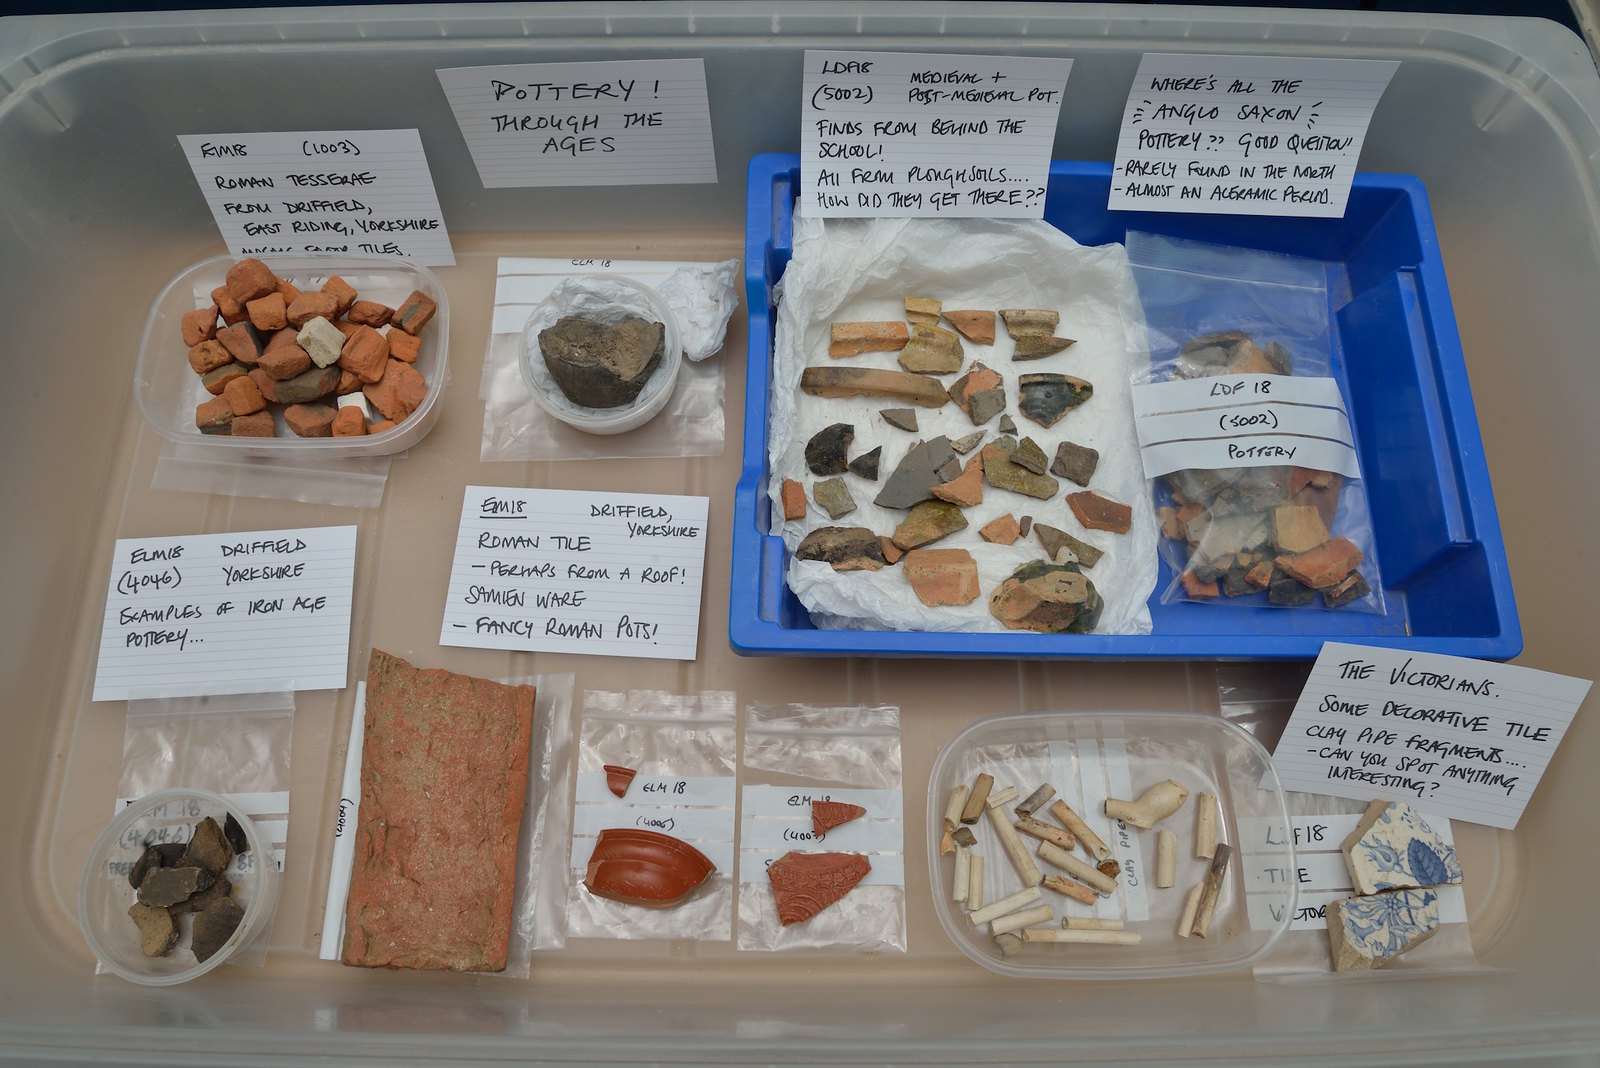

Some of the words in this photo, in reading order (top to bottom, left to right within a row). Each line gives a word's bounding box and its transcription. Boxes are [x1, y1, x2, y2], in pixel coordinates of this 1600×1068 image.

[910, 70, 983, 84] MEDIEVAL
[491, 80, 635, 102] POTTERY
[1227, 80, 1255, 93] ALL
[1272, 80, 1302, 94] THE
[812, 84, 873, 110] (5002)
[491, 115, 598, 134] THROUGH
[624, 112, 662, 128] THE
[1152, 104, 1218, 125] ANGLO
[1237, 105, 1301, 123] SAXON
[816, 120, 862, 137] FINDS
[874, 121, 916, 136] FROM
[931, 119, 988, 136] BEHIND
[997, 119, 1026, 134] THE
[303, 140, 360, 156] (1003)
[543, 136, 615, 156] AGES
[819, 142, 883, 161] SCHOOL!
[1238, 133, 1278, 157] GOOD
[1188, 161, 1230, 177] FOUND
[1240, 167, 1256, 178] IN
[1263, 164, 1288, 179] THE
[1293, 164, 1336, 179] NORTH
[215, 176, 274, 189] ROMAN
[286, 172, 376, 186] TESSERAE
[817, 192, 849, 209] HOW
[858, 193, 882, 208] DID
[887, 192, 922, 209] THEY
[930, 192, 961, 211] GET
[1181, 186, 1201, 199] AN
[224, 203, 272, 214] FROM
[243, 222, 281, 236] EAST
[292, 221, 354, 236] RIDING,
[355, 219, 439, 233] YORKSHIRE
[600, 259, 612, 268] 18
[1210, 381, 1245, 396] LDF
[1255, 381, 1271, 393] 18
[1220, 410, 1278, 431] (5002)
[1229, 444, 1296, 459] POTTERY
[628, 520, 699, 538] YORKSHIRE
[221, 539, 306, 557] DRIFFIELD
[478, 532, 539, 549] ROMAN
[550, 536, 591, 551] TILE
[117, 566, 181, 595] (4046)
[222, 563, 305, 586] YORKSHIRE
[568, 564, 610, 579] FROM
[619, 568, 630, 580] A
[641, 567, 685, 584] ROOF!
[248, 598, 284, 615] IRON
[293, 596, 326, 613] AGE
[537, 591, 587, 609] WARE
[476, 617, 533, 639] FANCY
[545, 618, 602, 639] ROMAN
[617, 615, 658, 645] POTS!
[1339, 660, 1375, 679] THE
[1319, 695, 1369, 716] SOME
[1381, 701, 1489, 734] DECORATIVE
[1506, 723, 1551, 741] TILE
[1306, 725, 1347, 745] CLAY
[1357, 727, 1397, 745] PIPE
[1360, 751, 1387, 767] YOU
[1395, 757, 1439, 774] SPOT
[1442, 763, 1519, 796] ANYTHING
[643, 783, 667, 793] ELM
[673, 782, 686, 794] 18
[1265, 824, 1328, 846] LF18
[1263, 868, 1313, 884] TIE
